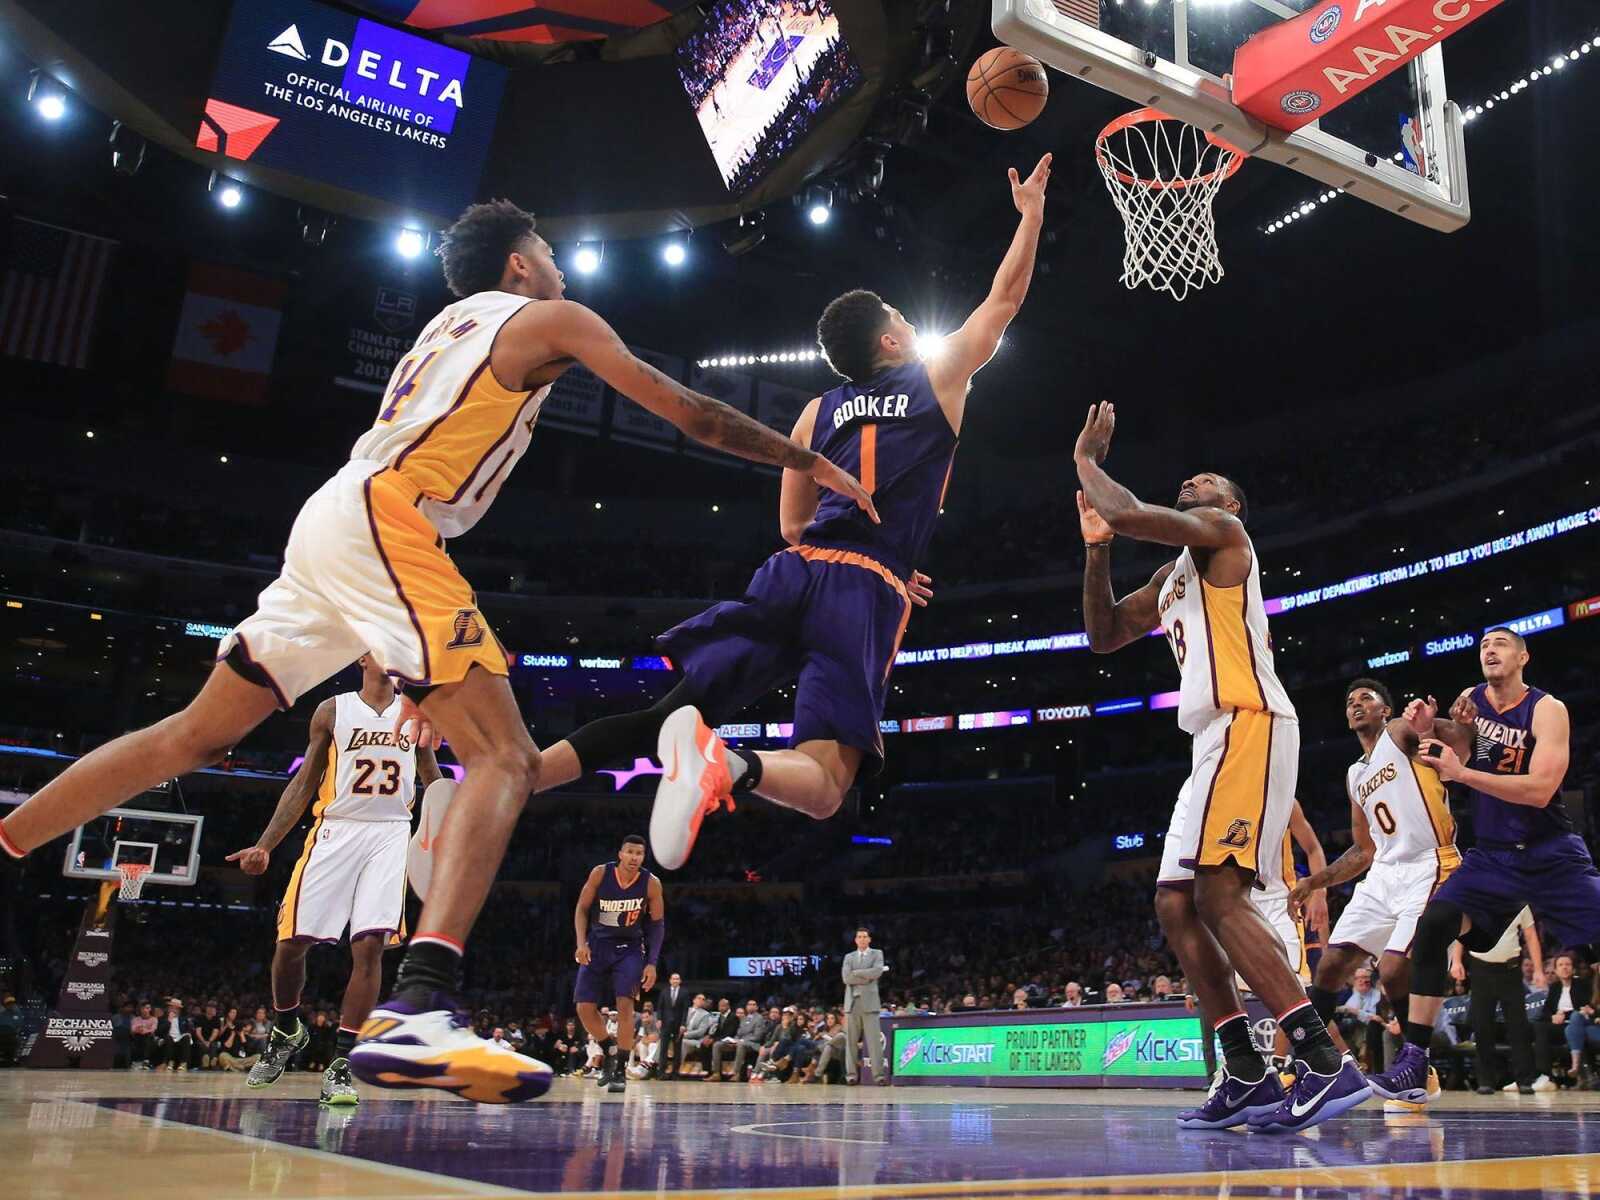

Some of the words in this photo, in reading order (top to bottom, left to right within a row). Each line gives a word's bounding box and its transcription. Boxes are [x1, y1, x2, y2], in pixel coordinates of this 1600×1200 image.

[1322, 0, 1488, 94] AAA.C
[321, 38, 465, 108] DELTA
[286, 72, 351, 103] OFFICIAL
[355, 95, 412, 121] AIRLINE
[414, 112, 434, 127] OF
[264, 82, 294, 102] THE
[296, 93, 324, 111] LOS
[327, 103, 392, 132] ANGELES
[395, 123, 447, 149] LAKERS
[346, 339, 401, 361] CHAMPI
[833, 393, 909, 430] BOOKER
[860, 423, 877, 496] 1
[1296, 589, 1321, 607] DAILY
[1322, 574, 1379, 600] DEPARTURES
[1380, 566, 1408, 585] FROM
[1408, 560, 1428, 578] LAX
[1429, 556, 1444, 571] TO
[1444, 549, 1470, 567] HELP
[1470, 542, 1491, 560] YOU
[1491, 531, 1525, 554] BREAK
[1525, 521, 1556, 544] AWAY
[1556, 511, 1588, 534] MORE
[1509, 614, 1551, 634] DELTA
[895, 651, 916, 664] ROM
[917, 649, 935, 662] LAX
[936, 647, 950, 660] TO
[950, 645, 973, 659] HELP
[973, 643, 992, 657] YOU
[993, 641, 1024, 654] BREAK
[1024, 638, 1053, 652] AWAY
[1426, 633, 1474, 655] StubHub
[522, 654, 568, 667] StubHub
[579, 656, 620, 669] verizon
[1368, 650, 1409, 669] verizon
[1036, 705, 1091, 721] TOYOTA
[713, 724, 760, 737] APLES
[1497, 747, 1525, 773] 21
[352, 759, 400, 795] 23
[1374, 802, 1396, 835] 0
[599, 898, 644, 912] PHOENIX
[48, 1018, 113, 1030] PECHANGA
[83, 1029, 113, 1037] CASINO
[1006, 1030, 1038, 1048] PROUD
[1041, 1028, 1087, 1048] PARTNER
[1136, 1031, 1204, 1063] KICKST
[922, 1038, 995, 1064] KICKSTART
[1009, 1051, 1021, 1071] OF
[1024, 1051, 1041, 1071] THE
[1044, 1051, 1083, 1071] LAKERS
